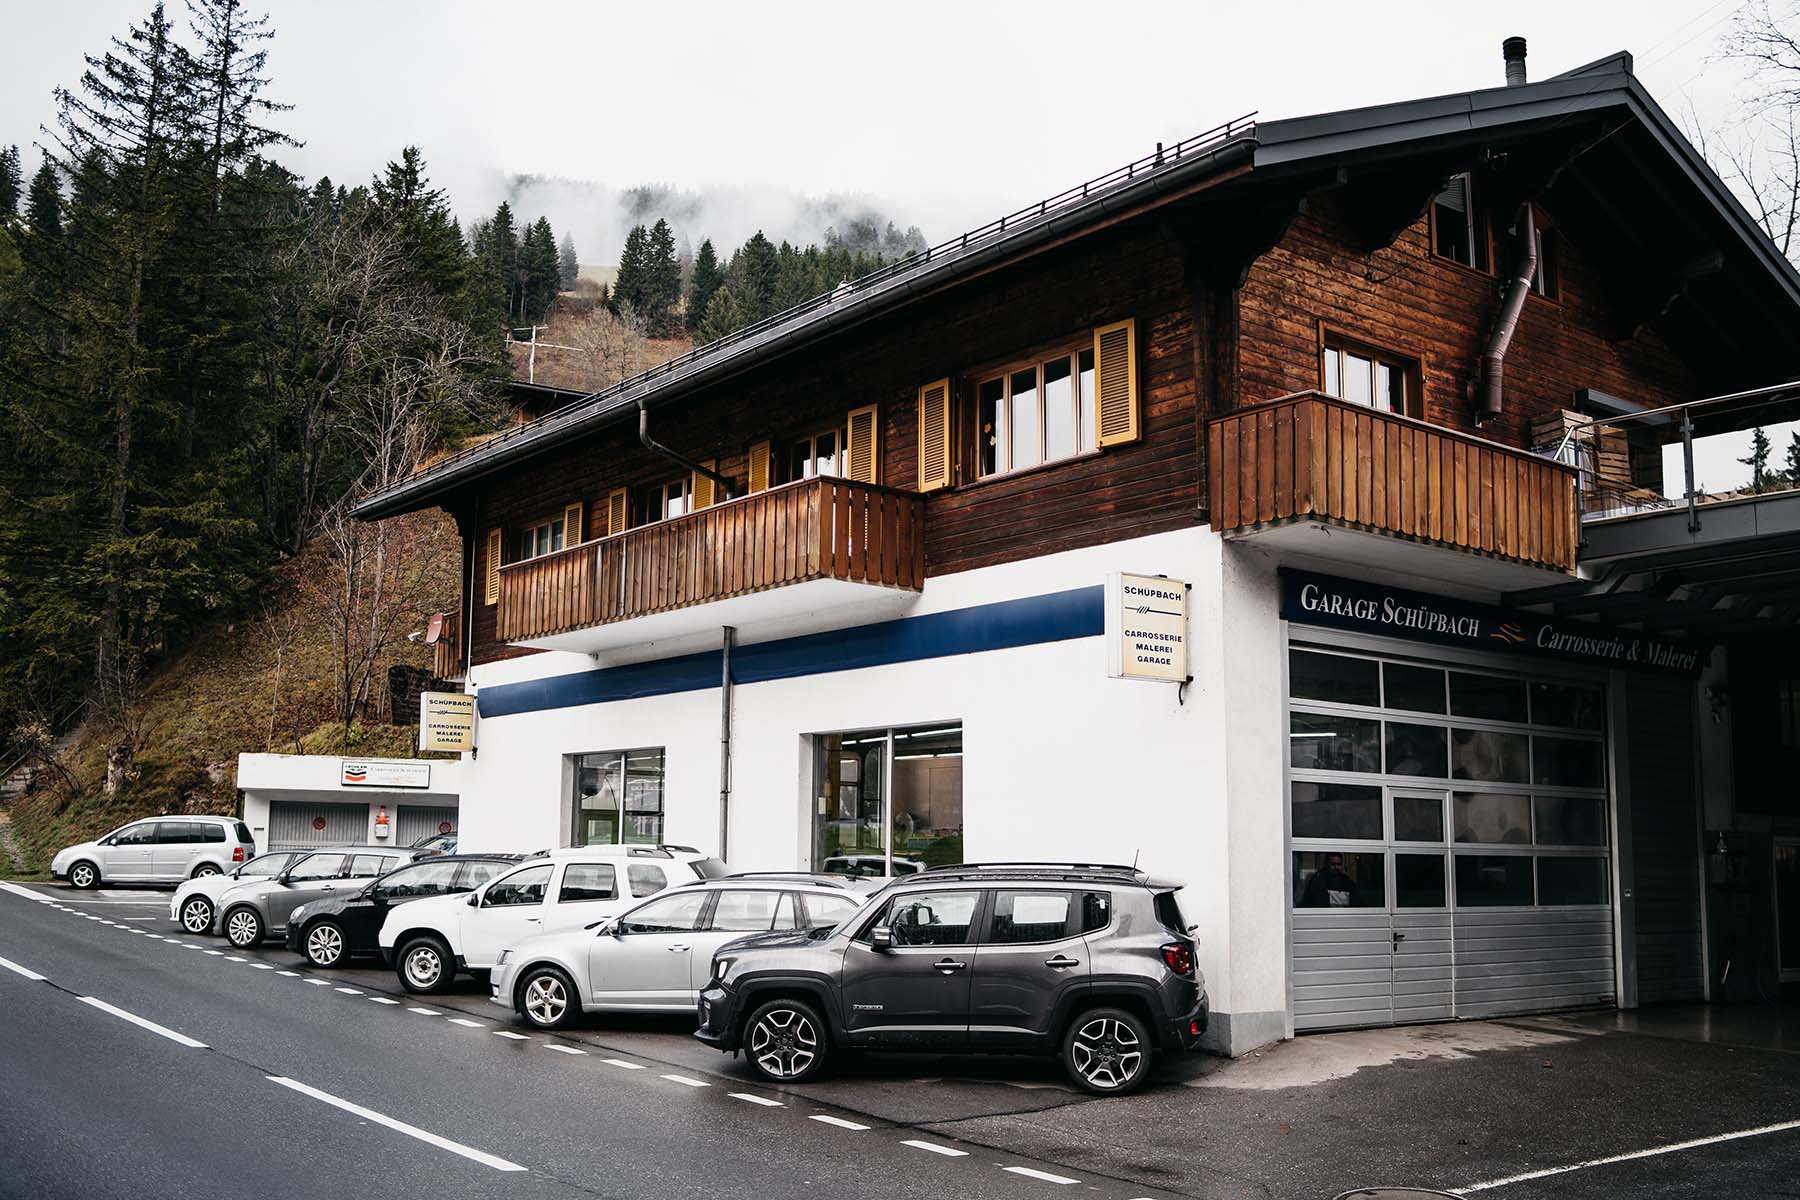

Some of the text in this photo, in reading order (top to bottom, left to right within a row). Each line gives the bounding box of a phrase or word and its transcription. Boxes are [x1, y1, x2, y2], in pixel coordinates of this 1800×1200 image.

[1124, 586, 1181, 600] SCHÜPBACH
[1300, 583, 1481, 637] GARAGE SCHÜPBACH
[1125, 630, 1182, 642] CARROSSERIE
[1136, 644, 1172, 653] MALEREI
[1536, 624, 1700, 671] Carrosserie & Malerei
[1137, 655, 1171, 665] GARAGE
